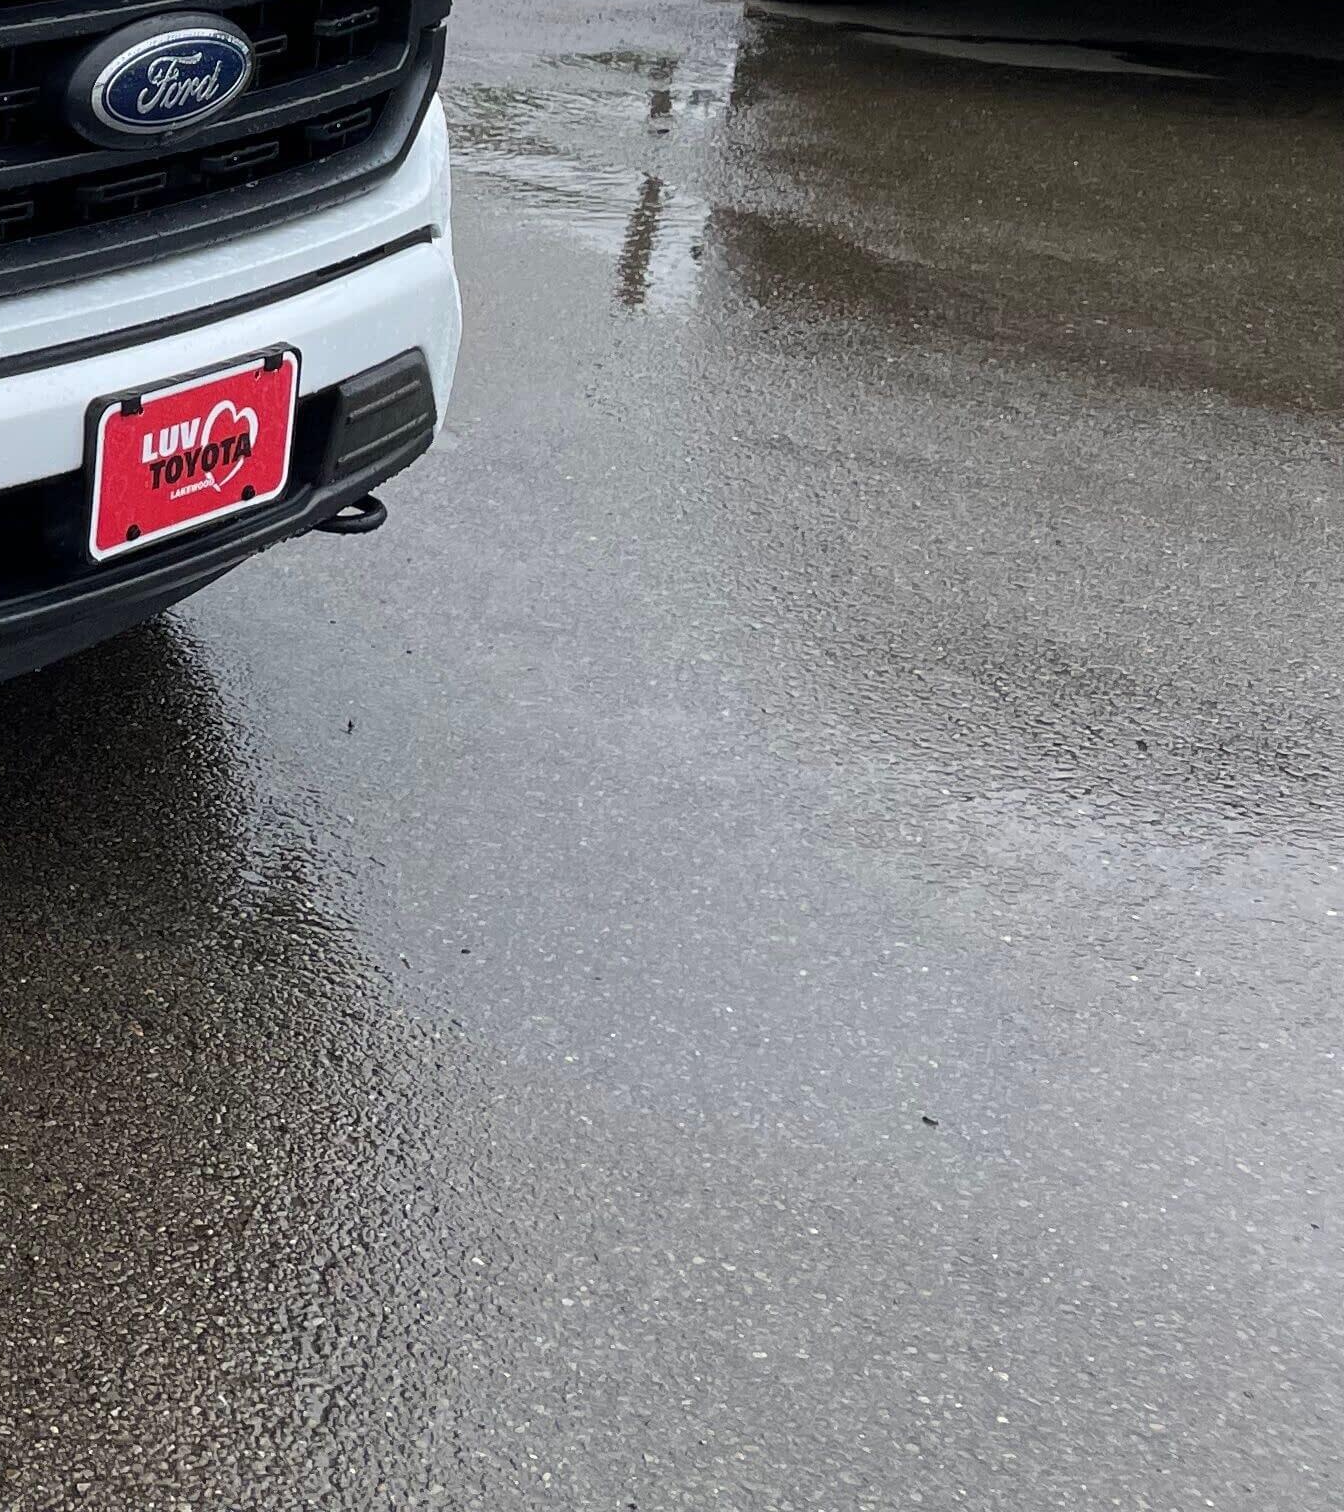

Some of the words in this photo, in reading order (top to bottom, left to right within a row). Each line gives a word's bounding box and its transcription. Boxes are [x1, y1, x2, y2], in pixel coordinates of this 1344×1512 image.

[137, 52, 223, 114] Ford
[142, 417, 201, 464] LUV
[150, 433, 252, 490] TOYOTA
